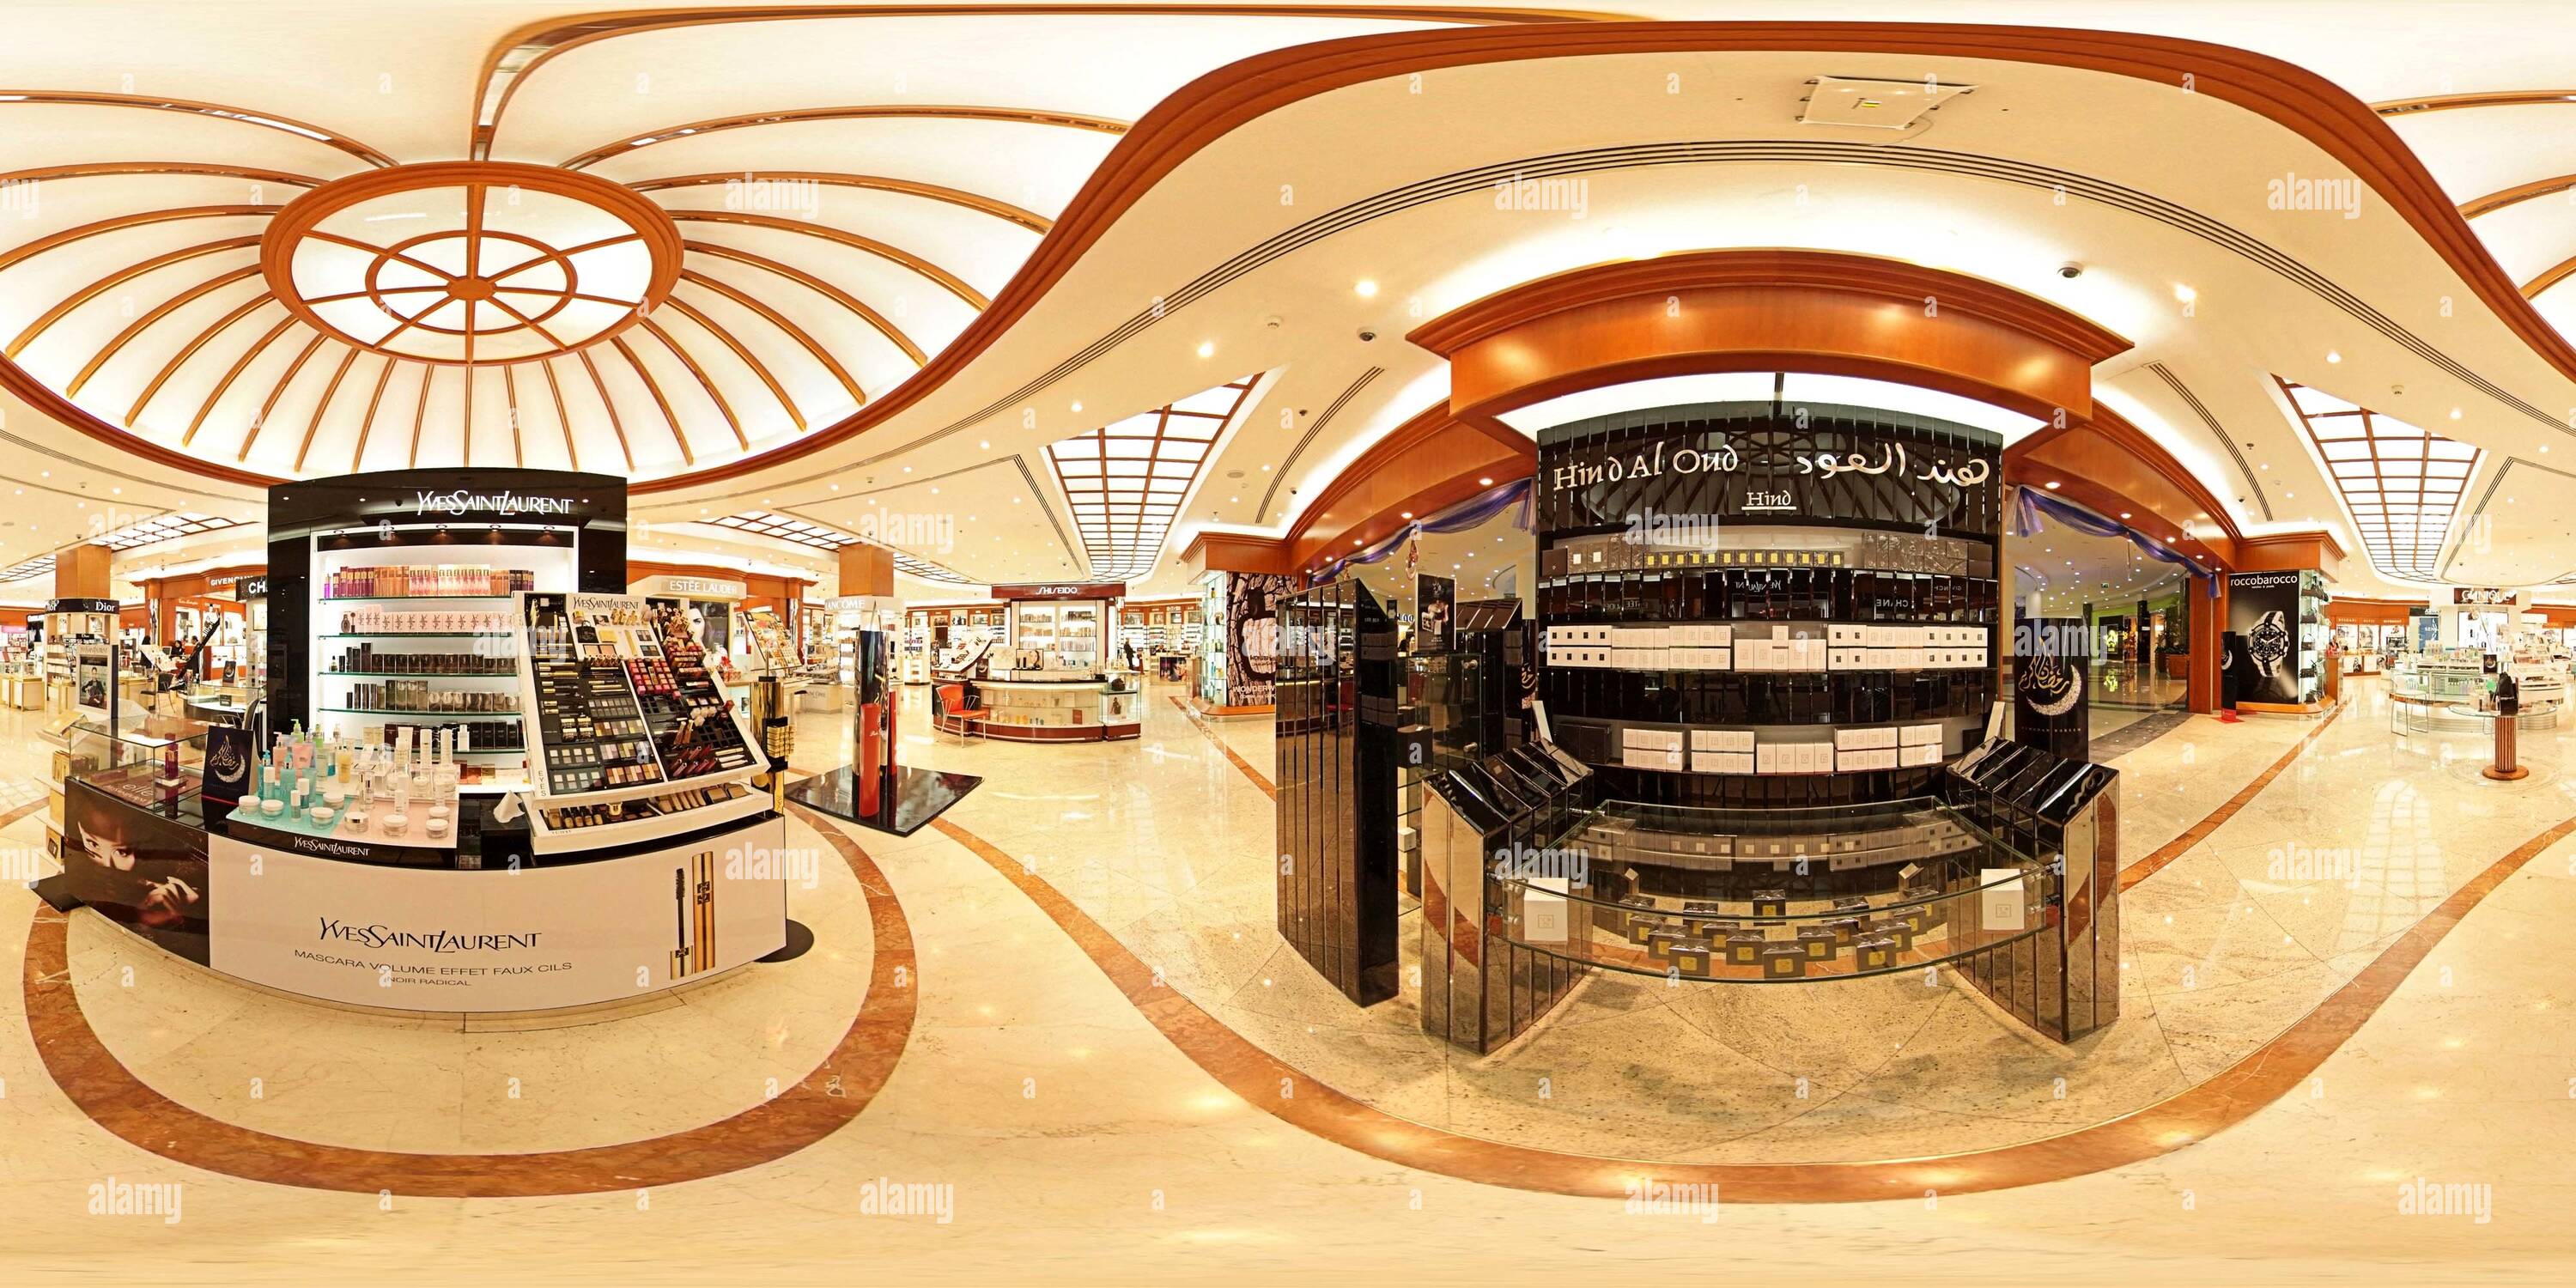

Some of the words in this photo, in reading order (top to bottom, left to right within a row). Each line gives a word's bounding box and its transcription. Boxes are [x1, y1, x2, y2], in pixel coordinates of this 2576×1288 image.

[1553, 456, 1623, 491] Hind
[1627, 441, 1664, 479] Al
[1673, 444, 1739, 474] Oud
[1747, 490, 1791, 506] Hind
[2230, 574, 2298, 586] roccobarocco
[1036, 586, 1078, 595] SHISEIDO
[95, 601, 115, 611] Dior
[538, 770, 547, 797] EYES
[295, 950, 366, 969] MASCARA
[369, 963, 435, 975] VOLUME
[440, 968, 489, 976] EFFET
[493, 966, 533, 975] FAUX
[538, 962, 573, 972] CILS
[385, 976, 416, 985] NOIR
